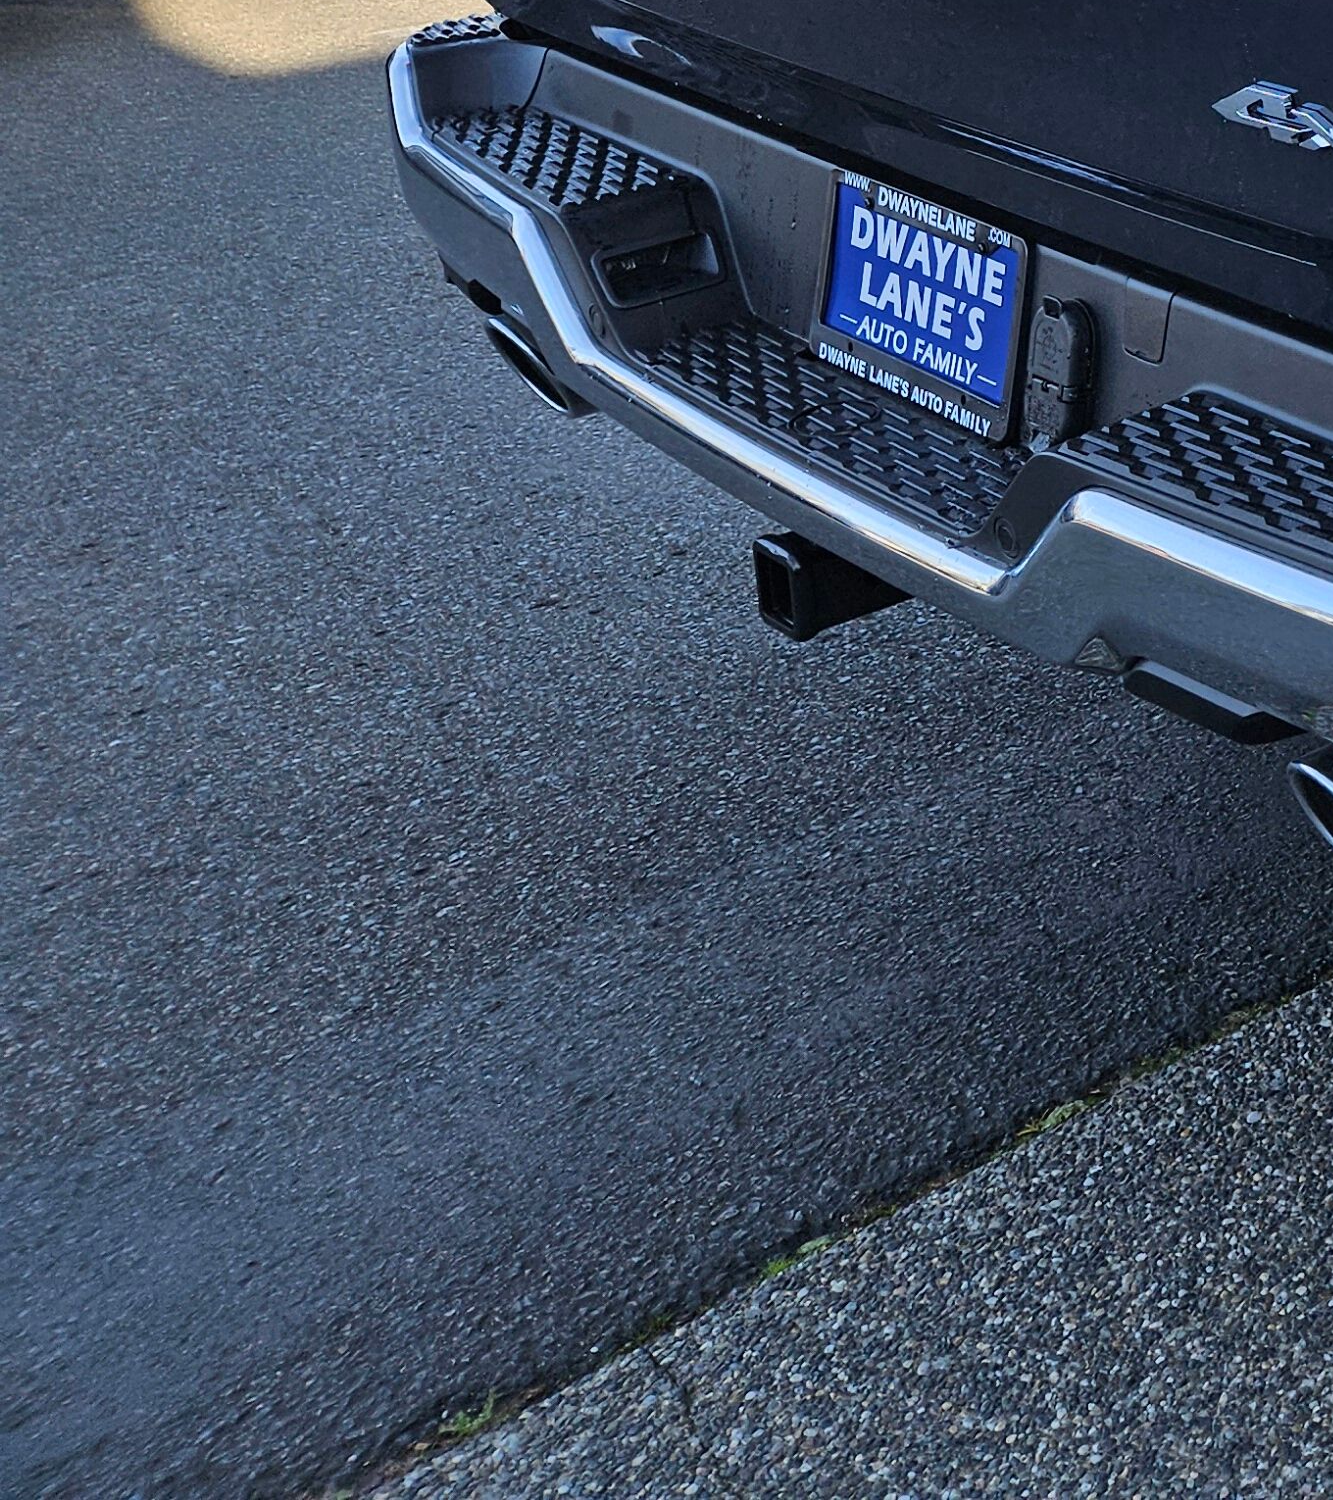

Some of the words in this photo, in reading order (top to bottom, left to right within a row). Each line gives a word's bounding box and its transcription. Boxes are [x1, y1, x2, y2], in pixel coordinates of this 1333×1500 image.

[850, 205, 1006, 307] DWAYNE
[878, 186, 977, 243] DWAYNELANE
[987, 227, 1011, 248] .COM
[856, 315, 908, 355] AUTO
[913, 338, 978, 386] FAMILY
[859, 262, 985, 351] LANE'S
[818, 342, 866, 378] DWAYNE
[869, 365, 909, 398] LANE'S
[911, 385, 943, 415] AUTO
[943, 401, 991, 438] FAMILY
